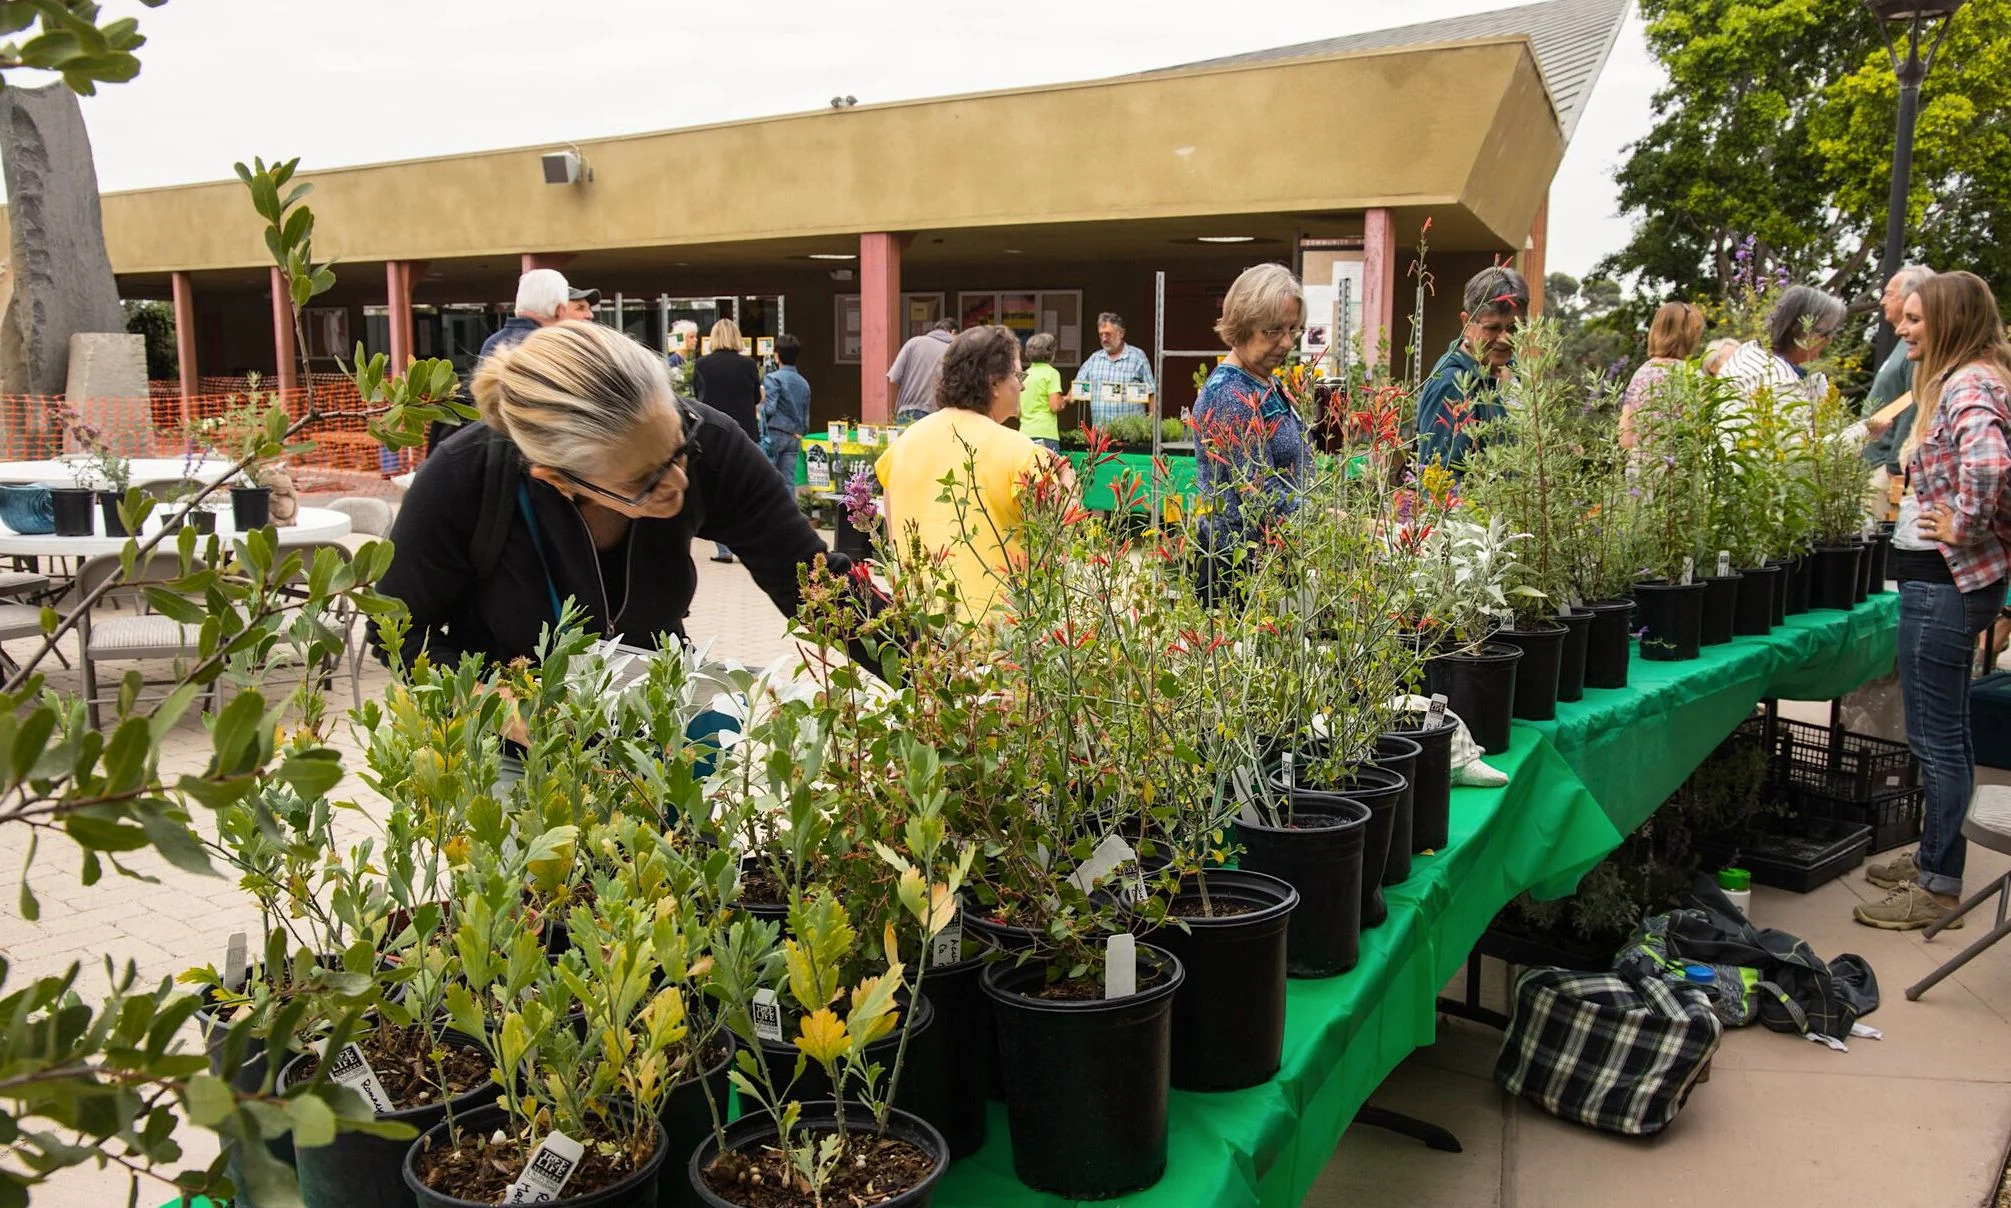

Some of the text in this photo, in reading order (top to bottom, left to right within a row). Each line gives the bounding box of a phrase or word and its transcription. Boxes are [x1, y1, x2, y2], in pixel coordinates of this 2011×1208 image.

[332, 1057, 358, 1071] LIFE
[536, 1157, 563, 1177] LIFE
[542, 1150, 570, 1171] TREE
[533, 1165, 561, 1182] NURSERY
